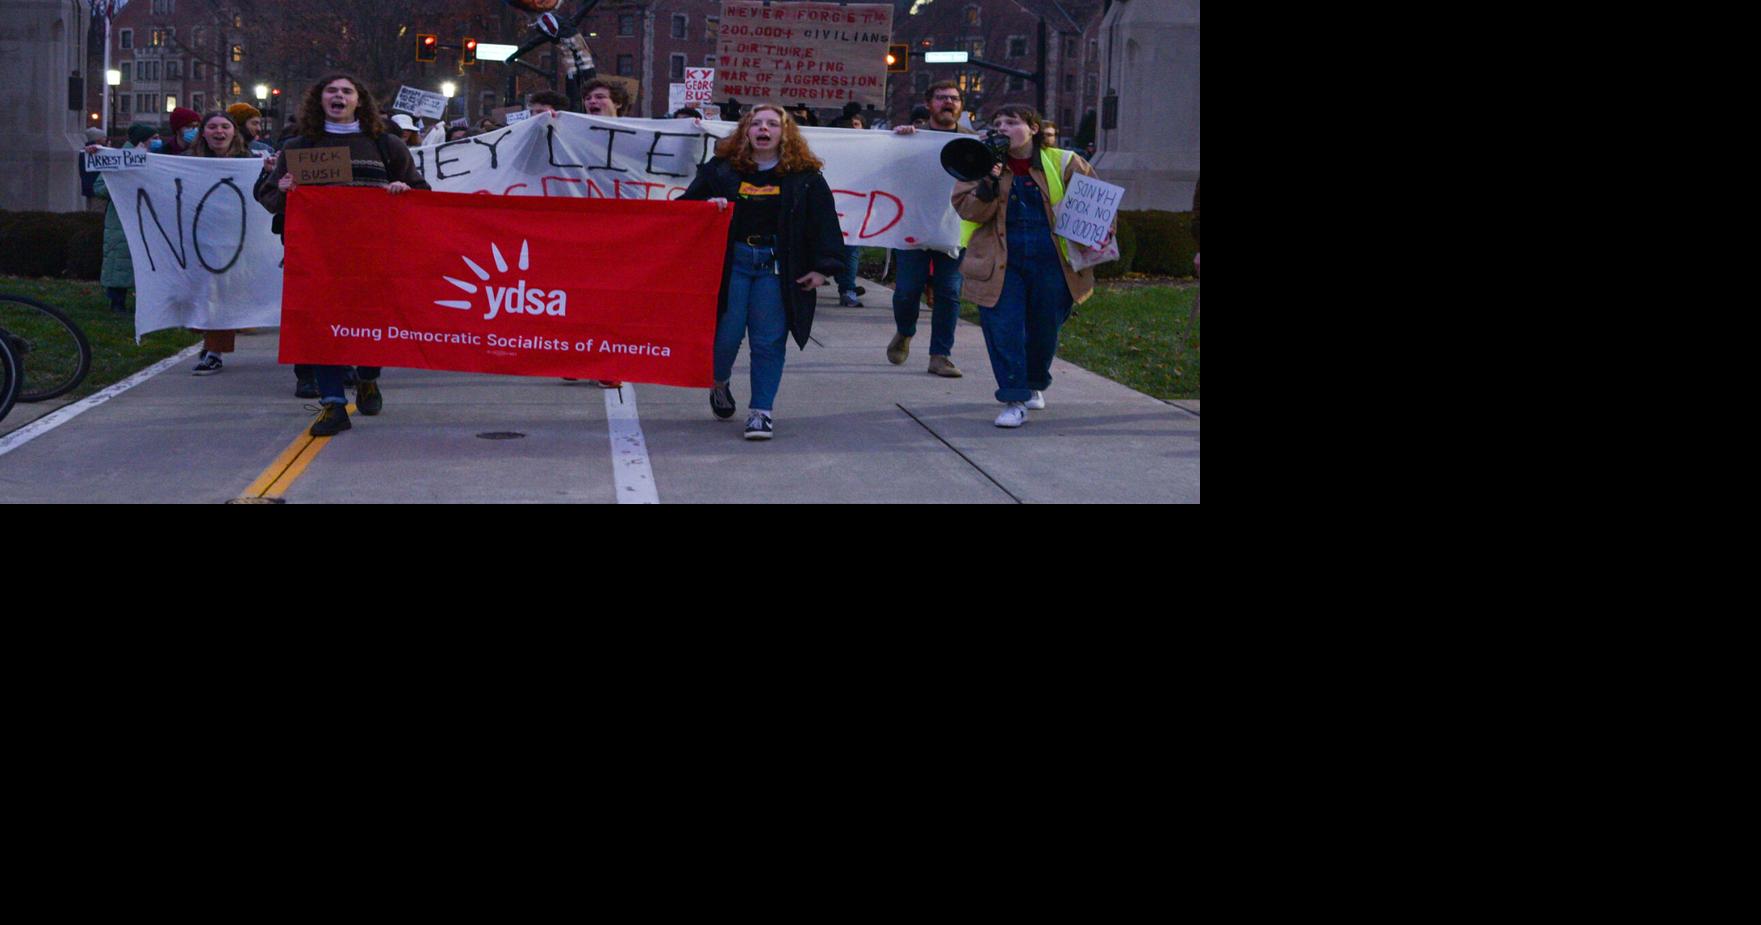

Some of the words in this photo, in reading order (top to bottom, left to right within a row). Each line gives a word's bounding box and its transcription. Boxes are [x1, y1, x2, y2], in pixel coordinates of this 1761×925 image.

[721, 40, 814, 58] TORTURE
[720, 56, 761, 69] WIRE
[774, 60, 845, 72] TAPPING
[686, 70, 712, 79] KY
[720, 70, 748, 82] WAR
[756, 73, 773, 83] OF
[724, 85, 770, 97] NEVER
[299, 151, 341, 162] FUCK
[302, 168, 340, 180] BUSH
[1095, 207, 1111, 222] ON
[136, 177, 247, 274] NO
[1072, 219, 1105, 242] BLOOD
[484, 280, 567, 320] ydsa
[331, 324, 382, 341] Young
[387, 326, 481, 346] Democratic
[487, 333, 569, 352] Socialists
[575, 339, 593, 353] of
[599, 340, 671, 357] America
